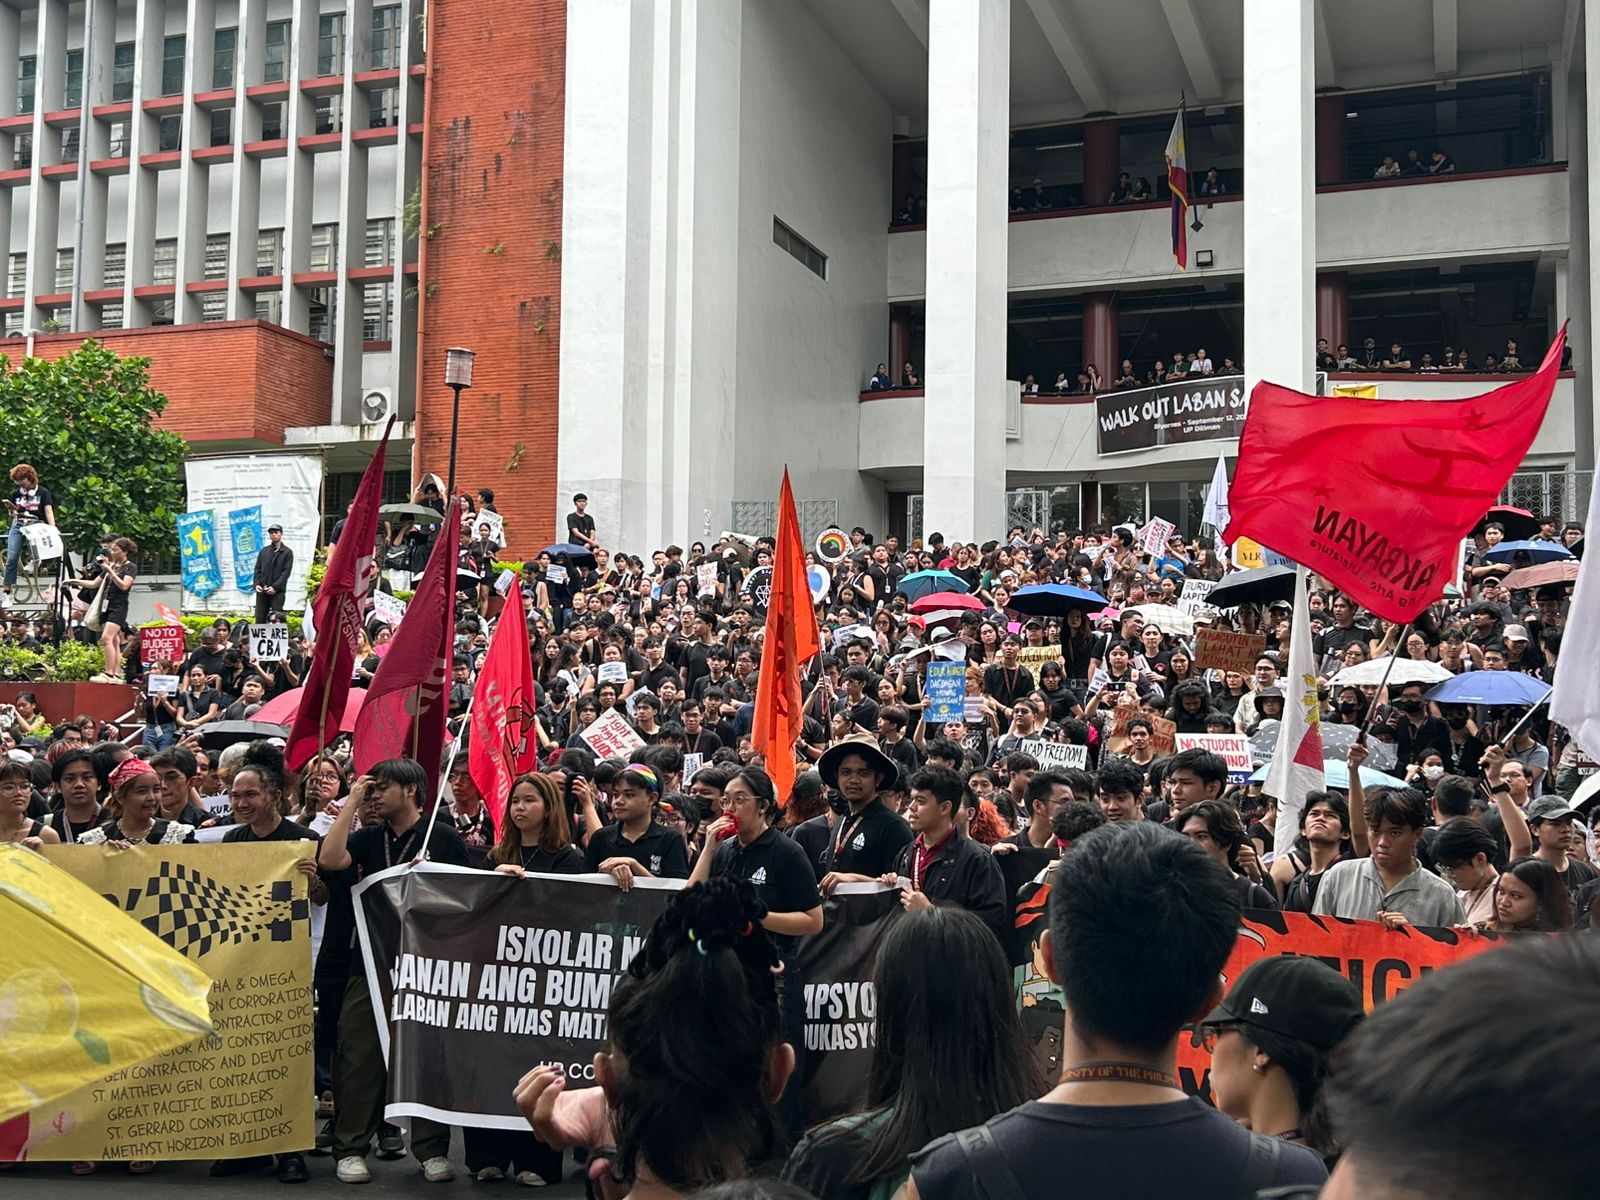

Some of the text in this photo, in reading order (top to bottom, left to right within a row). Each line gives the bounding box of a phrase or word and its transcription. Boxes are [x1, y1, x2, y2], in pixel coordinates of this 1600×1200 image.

[1100, 405, 1140, 432] WALK
[1142, 396, 1170, 420] OUT
[1173, 389, 1226, 415] LABAN
[1187, 416, 1225, 427] September
[1183, 424, 1221, 433] UP Diliman
[1183, 592, 1206, 600] KAPIT
[1185, 581, 1213, 591] BURU
[142, 638, 180, 649] BUDGET
[145, 628, 177, 638] NO TO
[251, 627, 288, 639] WE ARE
[257, 639, 281, 657] CBA
[1203, 642, 1245, 658] LAHAT
[1023, 742, 1083, 763] ACAD FREEDOM.
[1180, 738, 1246, 752] NO STUDENT
[496, 925, 645, 971] ISKOLAR N
[213, 970, 297, 993] HA & OMEGA
[477, 964, 537, 1004] ANG
[544, 969, 621, 1010] BUM
[209, 986, 314, 1013] ON CORPORATION
[212, 1004, 311, 1031] ONTRACTOR OPC
[390, 993, 451, 1028] LABAN
[454, 1002, 499, 1032] ANG
[503, 1006, 553, 1037] MAS
[198, 1037, 223, 1052] AND
[228, 1022, 314, 1048] CONSTRUCTIO
[131, 1057, 216, 1080] CONTRACTORS
[220, 1054, 246, 1069] AND
[251, 1048, 284, 1066] DEVT
[288, 1039, 314, 1058] COR
[569, 1062, 596, 1080] CO
[1099, 1066, 1113, 1077] OF
[1118, 1067, 1141, 1079] THE
[110, 1081, 173, 1103] MATTHEW
[209, 1066, 289, 1089] CONTRACTOR
[107, 1087, 274, 1122] GREAT PACIFIC BUILDERS
[106, 1104, 283, 1141] ST. GERRARD CONSTRUCTION
[101, 1120, 294, 1160] AMETHYST HORIZON BUILDERS
